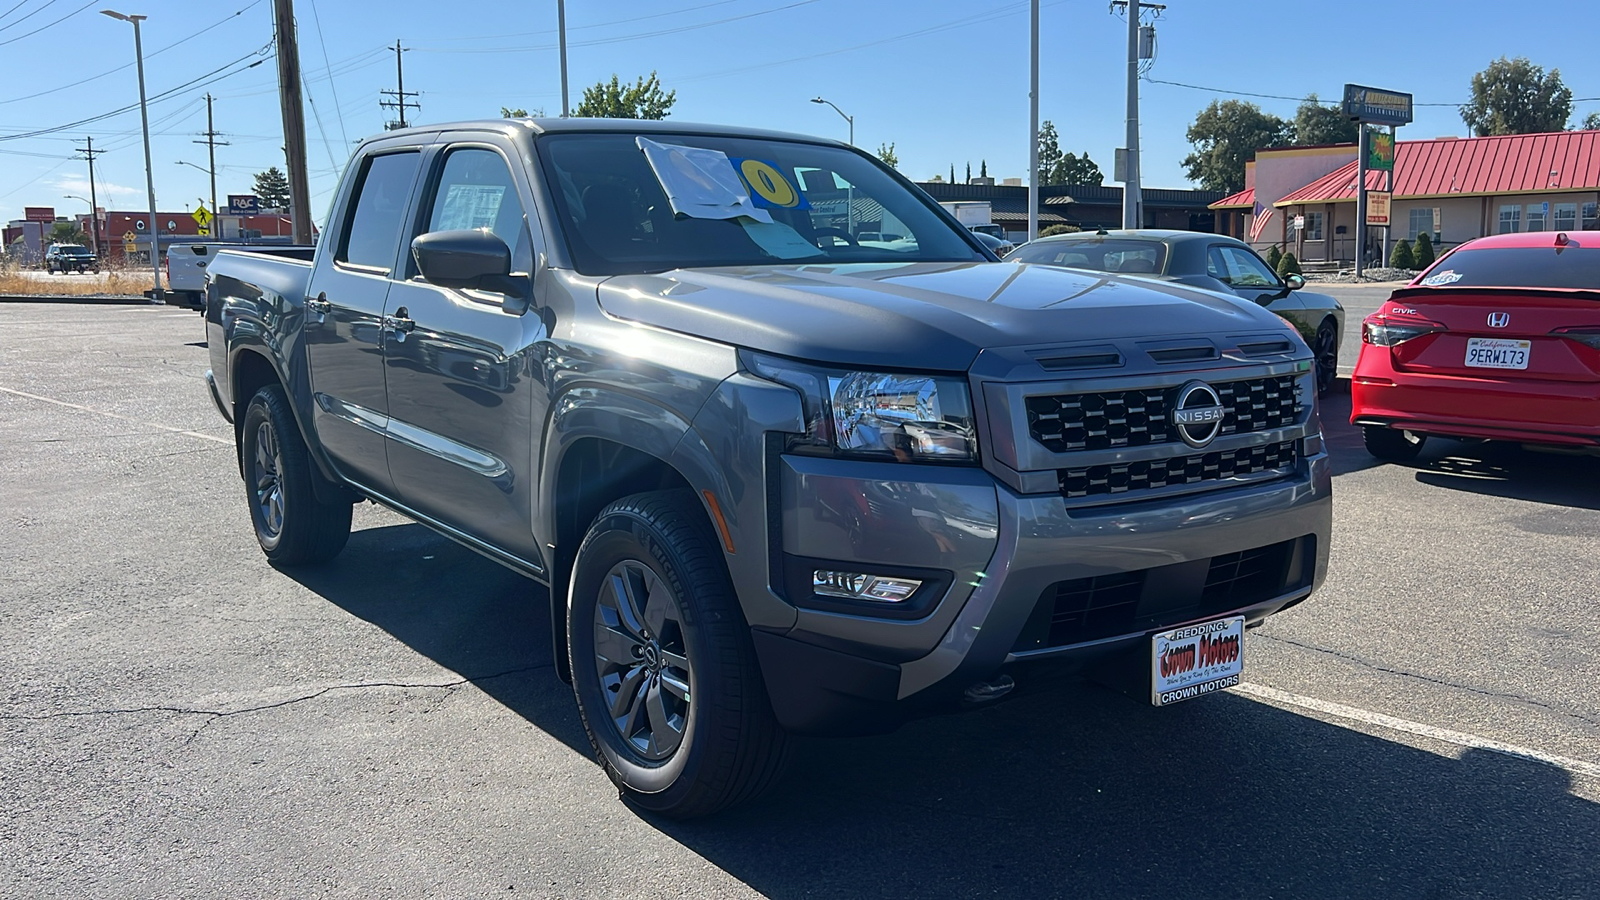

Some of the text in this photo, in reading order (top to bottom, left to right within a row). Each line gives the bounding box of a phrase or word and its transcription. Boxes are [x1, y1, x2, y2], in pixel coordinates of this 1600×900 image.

[735, 160, 799, 208] 0
[233, 198, 254, 209] RAC
[1392, 307, 1417, 315] CIVIC
[1480, 340, 1518, 350] California
[1469, 349, 1525, 365] 9ERW173
[1176, 409, 1225, 422] NISSAN
[650, 543, 693, 623] MICHELIN
[1176, 622, 1223, 640] REDDING
[1160, 632, 1239, 678] Crown Motors
[1161, 675, 1239, 703] CROWN MOTORS
